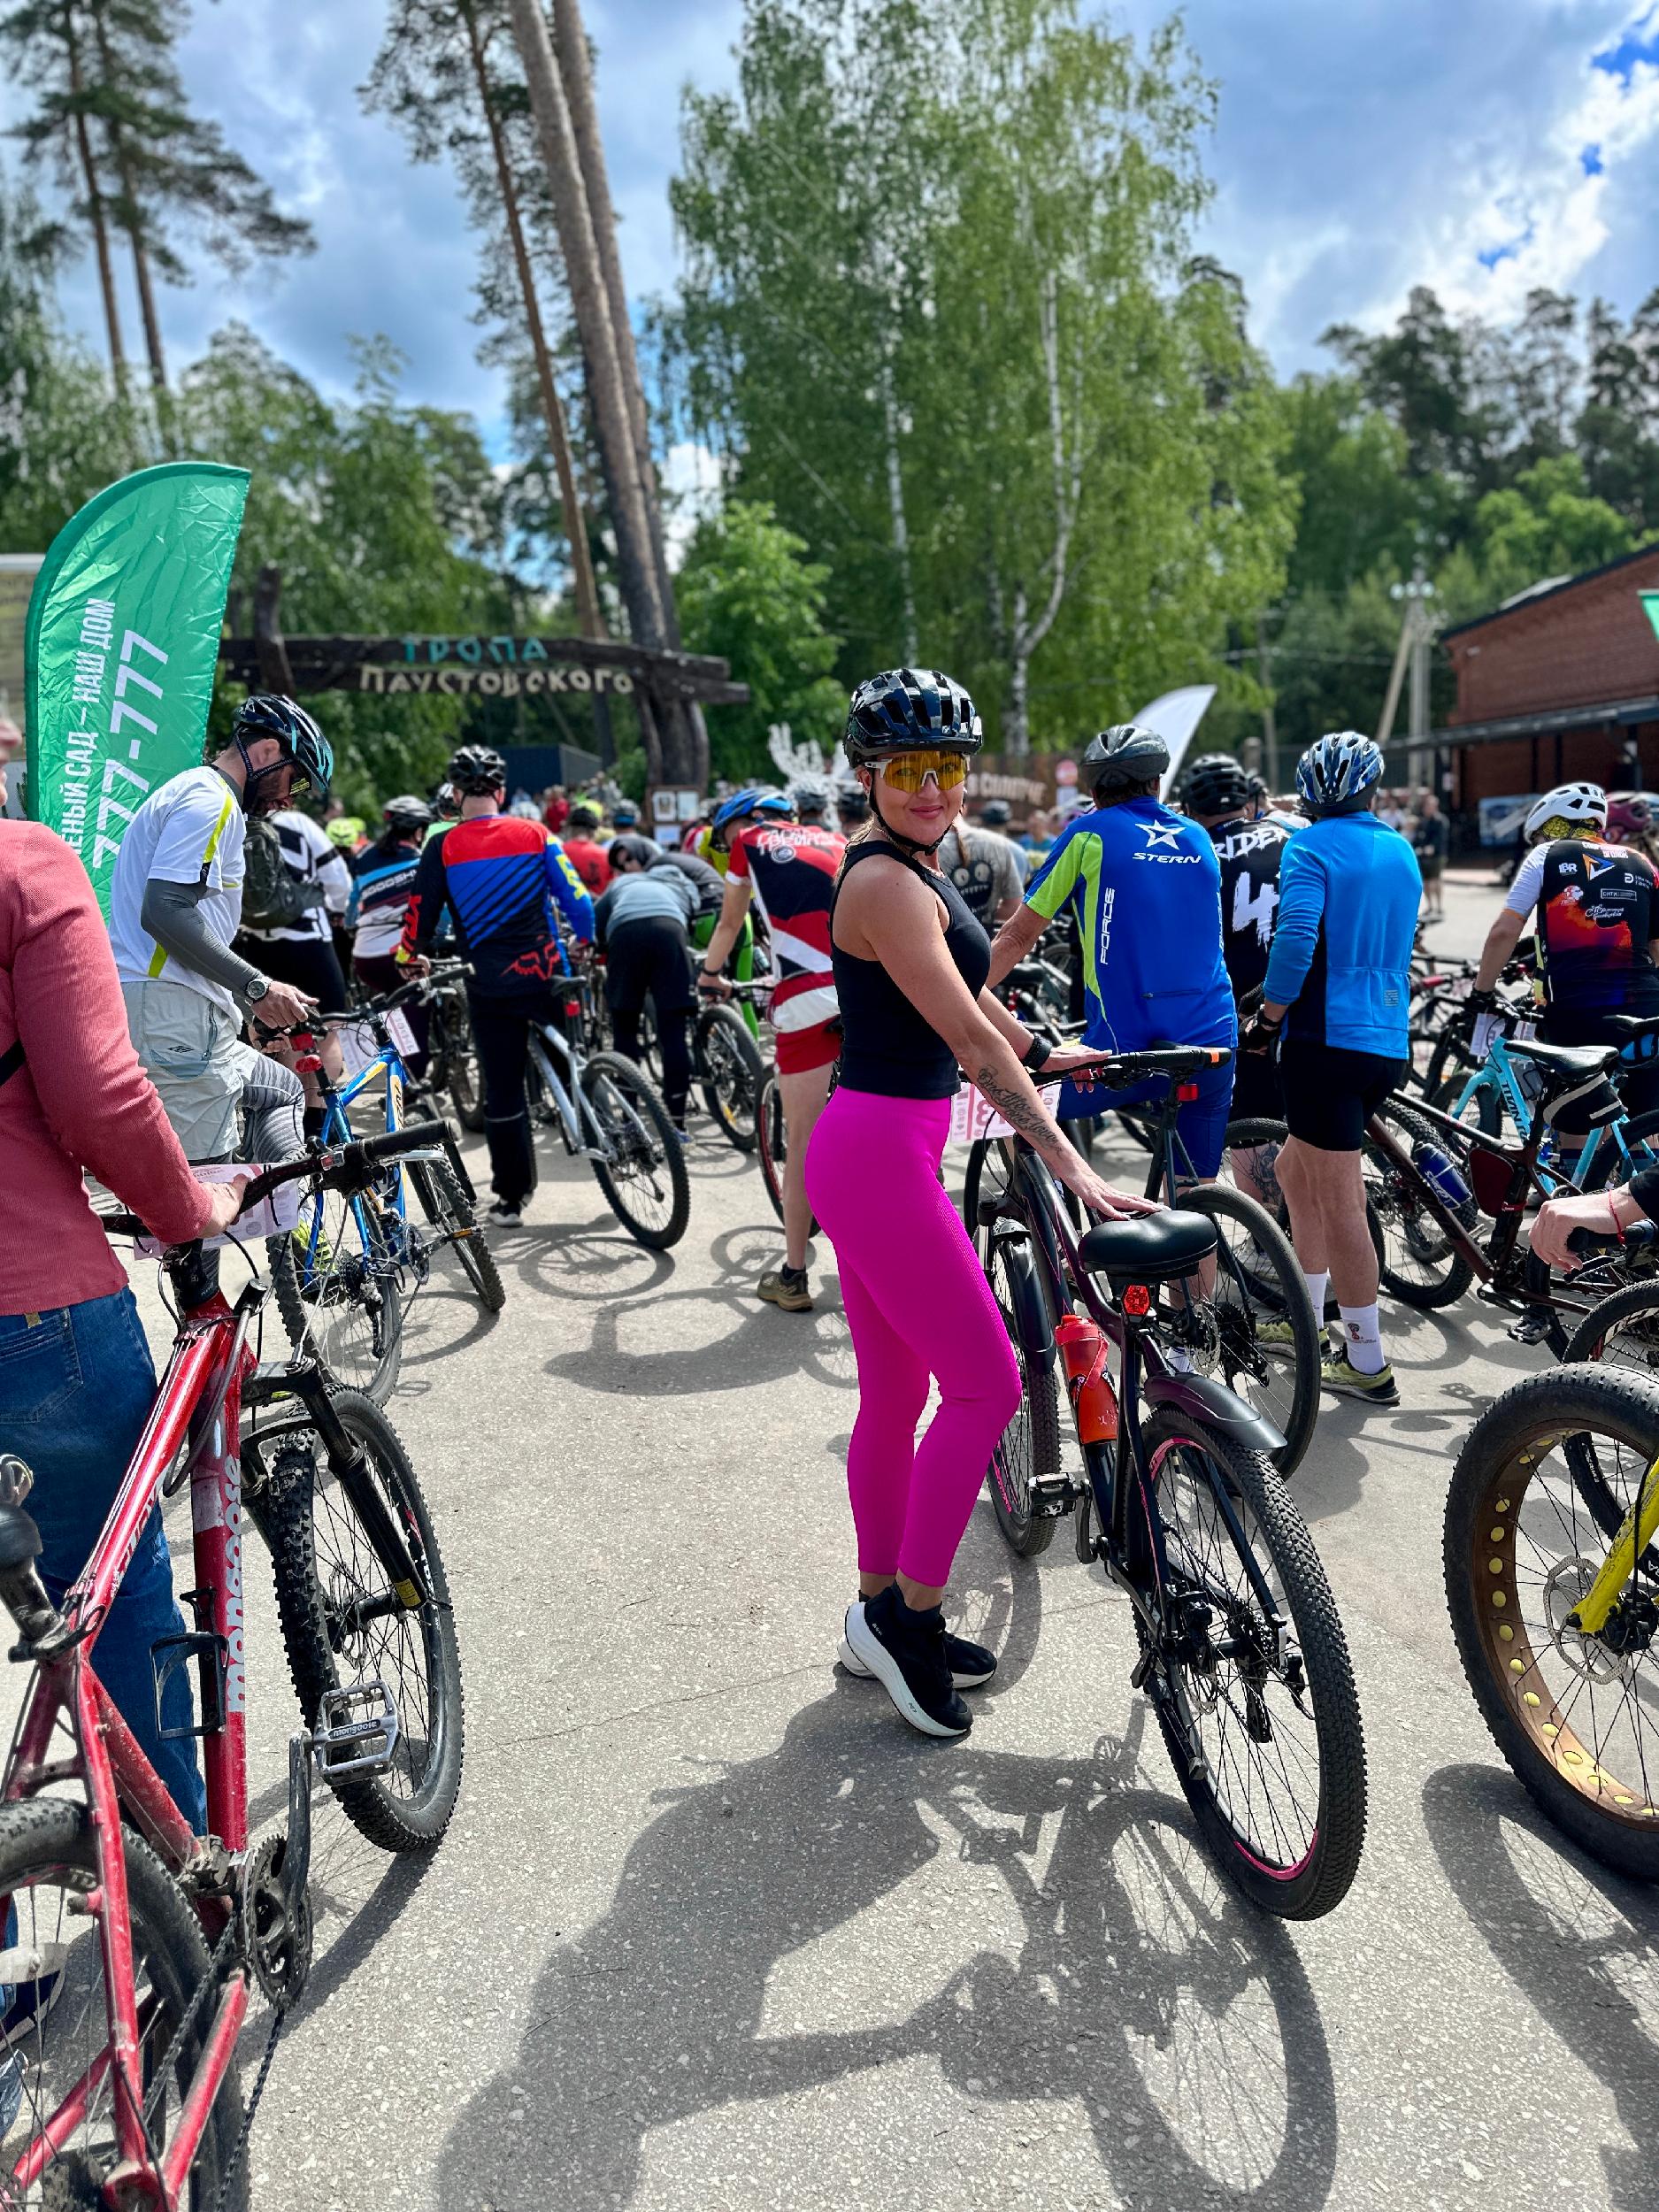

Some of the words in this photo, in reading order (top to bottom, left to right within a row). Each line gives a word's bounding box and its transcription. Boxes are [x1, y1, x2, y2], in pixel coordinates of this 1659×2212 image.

[81, 597, 116, 650] ДОМ
[403, 635, 549, 663] ТРОПА
[73, 653, 107, 703] НАШ
[65, 730, 99, 777] САД
[93, 629, 168, 868] 777-777
[59, 782, 89, 855] ЕНЫЙ
[1133, 852, 1202, 864] STERN
[1100, 887, 1115, 964] FORCE
[1233, 872, 1281, 953] 4
[225, 1455, 245, 1712] mongoose
